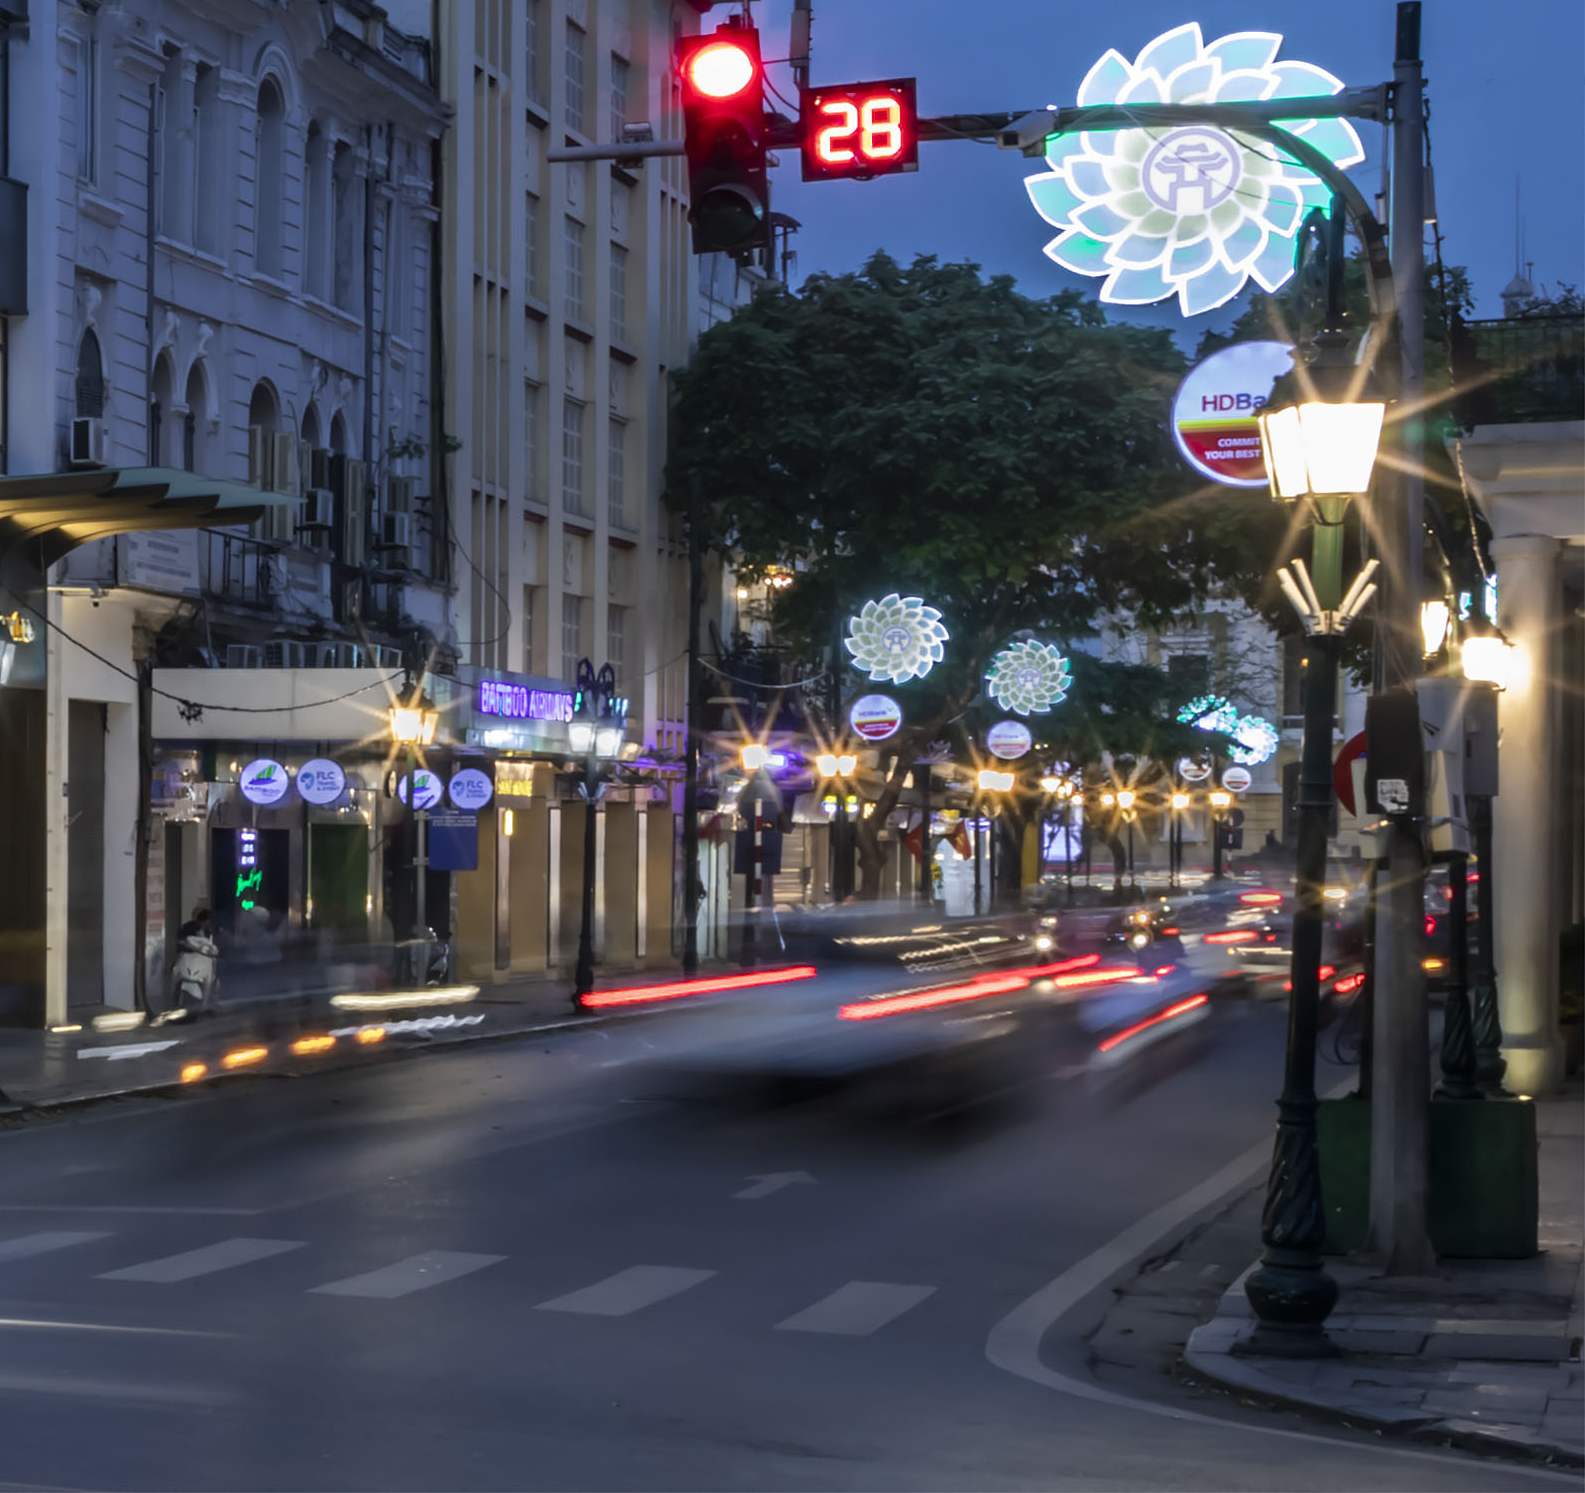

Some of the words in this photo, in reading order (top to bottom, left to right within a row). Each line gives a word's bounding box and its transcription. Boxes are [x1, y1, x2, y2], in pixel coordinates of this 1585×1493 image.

[818, 98, 902, 162] 28
[1201, 392, 1267, 412] HDBa
[1204, 450, 1234, 460] YOUR
[1235, 449, 1261, 459] BEST
